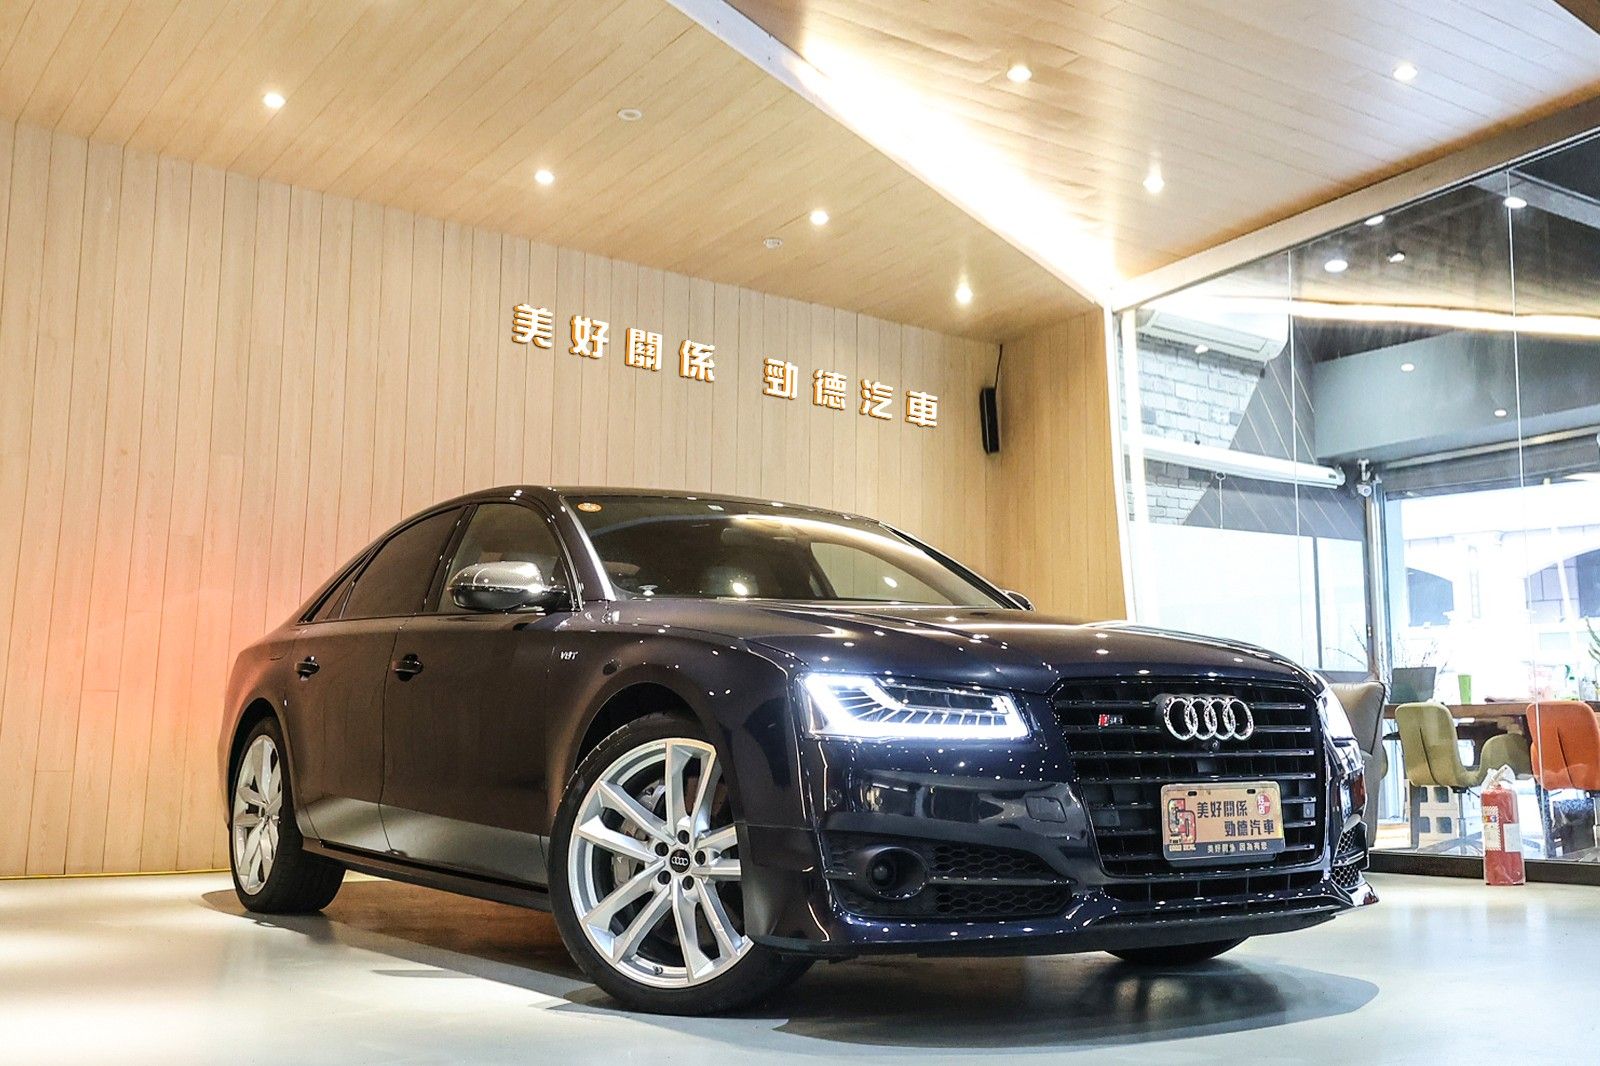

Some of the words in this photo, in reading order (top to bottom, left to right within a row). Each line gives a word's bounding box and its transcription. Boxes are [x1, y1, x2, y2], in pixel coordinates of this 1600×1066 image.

[512, 303, 715, 382] 美好關係
[763, 358, 938, 428] 勁德汽車
[1197, 800, 1248, 818] 美好關係
[1224, 819, 1274, 837] 勁德汽車
